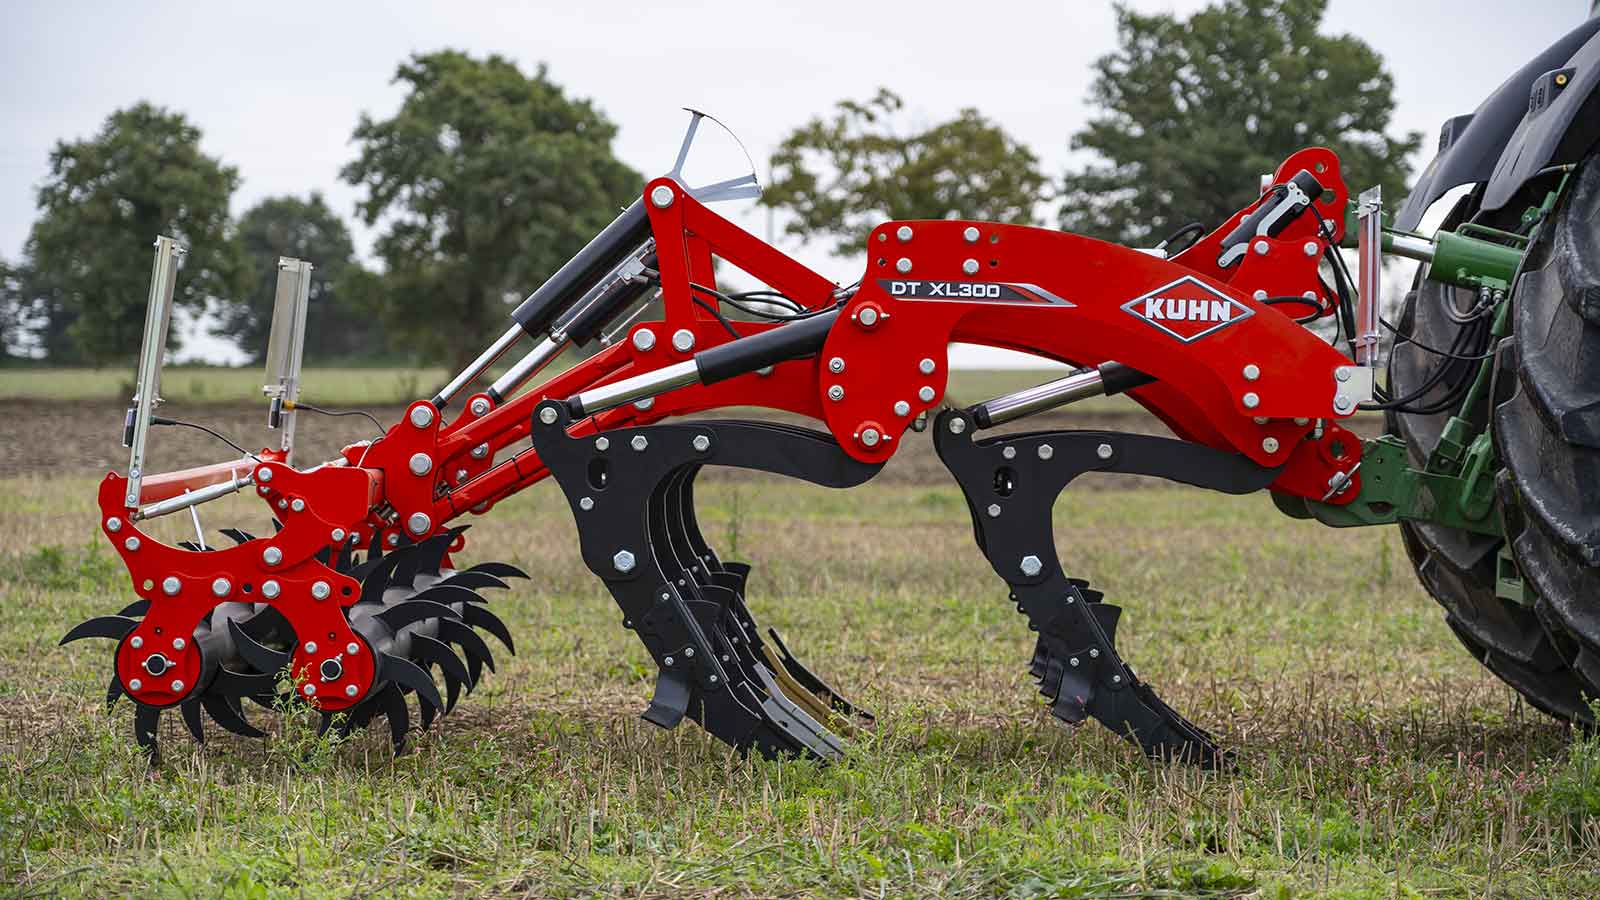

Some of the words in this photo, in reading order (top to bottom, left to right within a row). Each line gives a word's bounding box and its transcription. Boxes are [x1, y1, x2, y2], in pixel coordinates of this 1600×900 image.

[891, 281, 921, 296] DT
[929, 282, 1000, 298] XL300
[1145, 298, 1231, 322] KUHN
